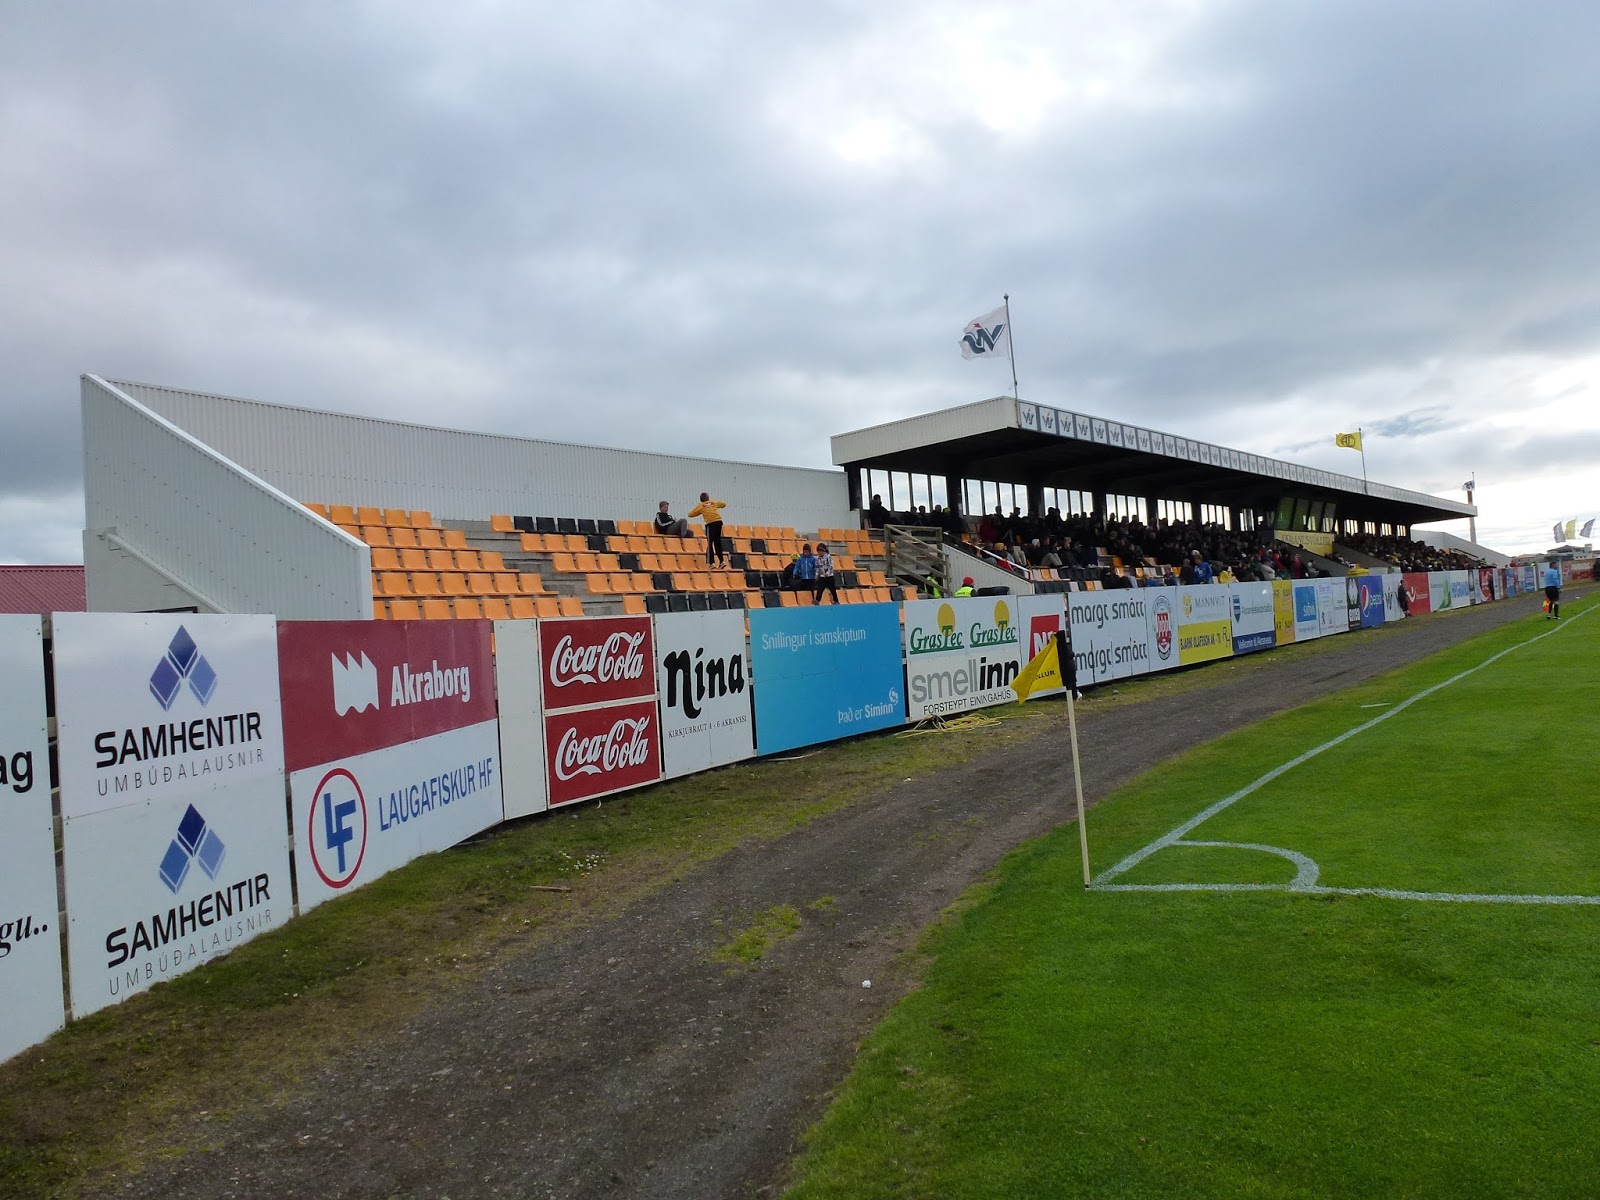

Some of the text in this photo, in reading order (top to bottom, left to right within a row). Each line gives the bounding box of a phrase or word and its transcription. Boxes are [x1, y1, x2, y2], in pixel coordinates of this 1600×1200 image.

[762, 627, 866, 652] Snillingur í samskiptum
[910, 625, 963, 652] GrasTec
[970, 620, 1017, 646] GrasTec
[550, 630, 646, 688] Coca-Cola
[911, 656, 1019, 703] smellinn
[390, 660, 471, 707] Akraborg
[923, 698, 967, 716] FORSTEYPT
[668, 723, 708, 738] KIRKJUBRAUT
[838, 707, 853, 724] Það
[854, 708, 863, 720] er
[94, 711, 263, 769] SAMHENTIR
[554, 714, 651, 781] Coca-Cola
[97, 748, 264, 796] UMBÚÐALAUSNIR
[378, 757, 493, 832] LAUGAFISKUR HF
[105, 873, 271, 969] SAMHENTIR
[109, 909, 272, 996] UMBÚÐALAUSNIR
